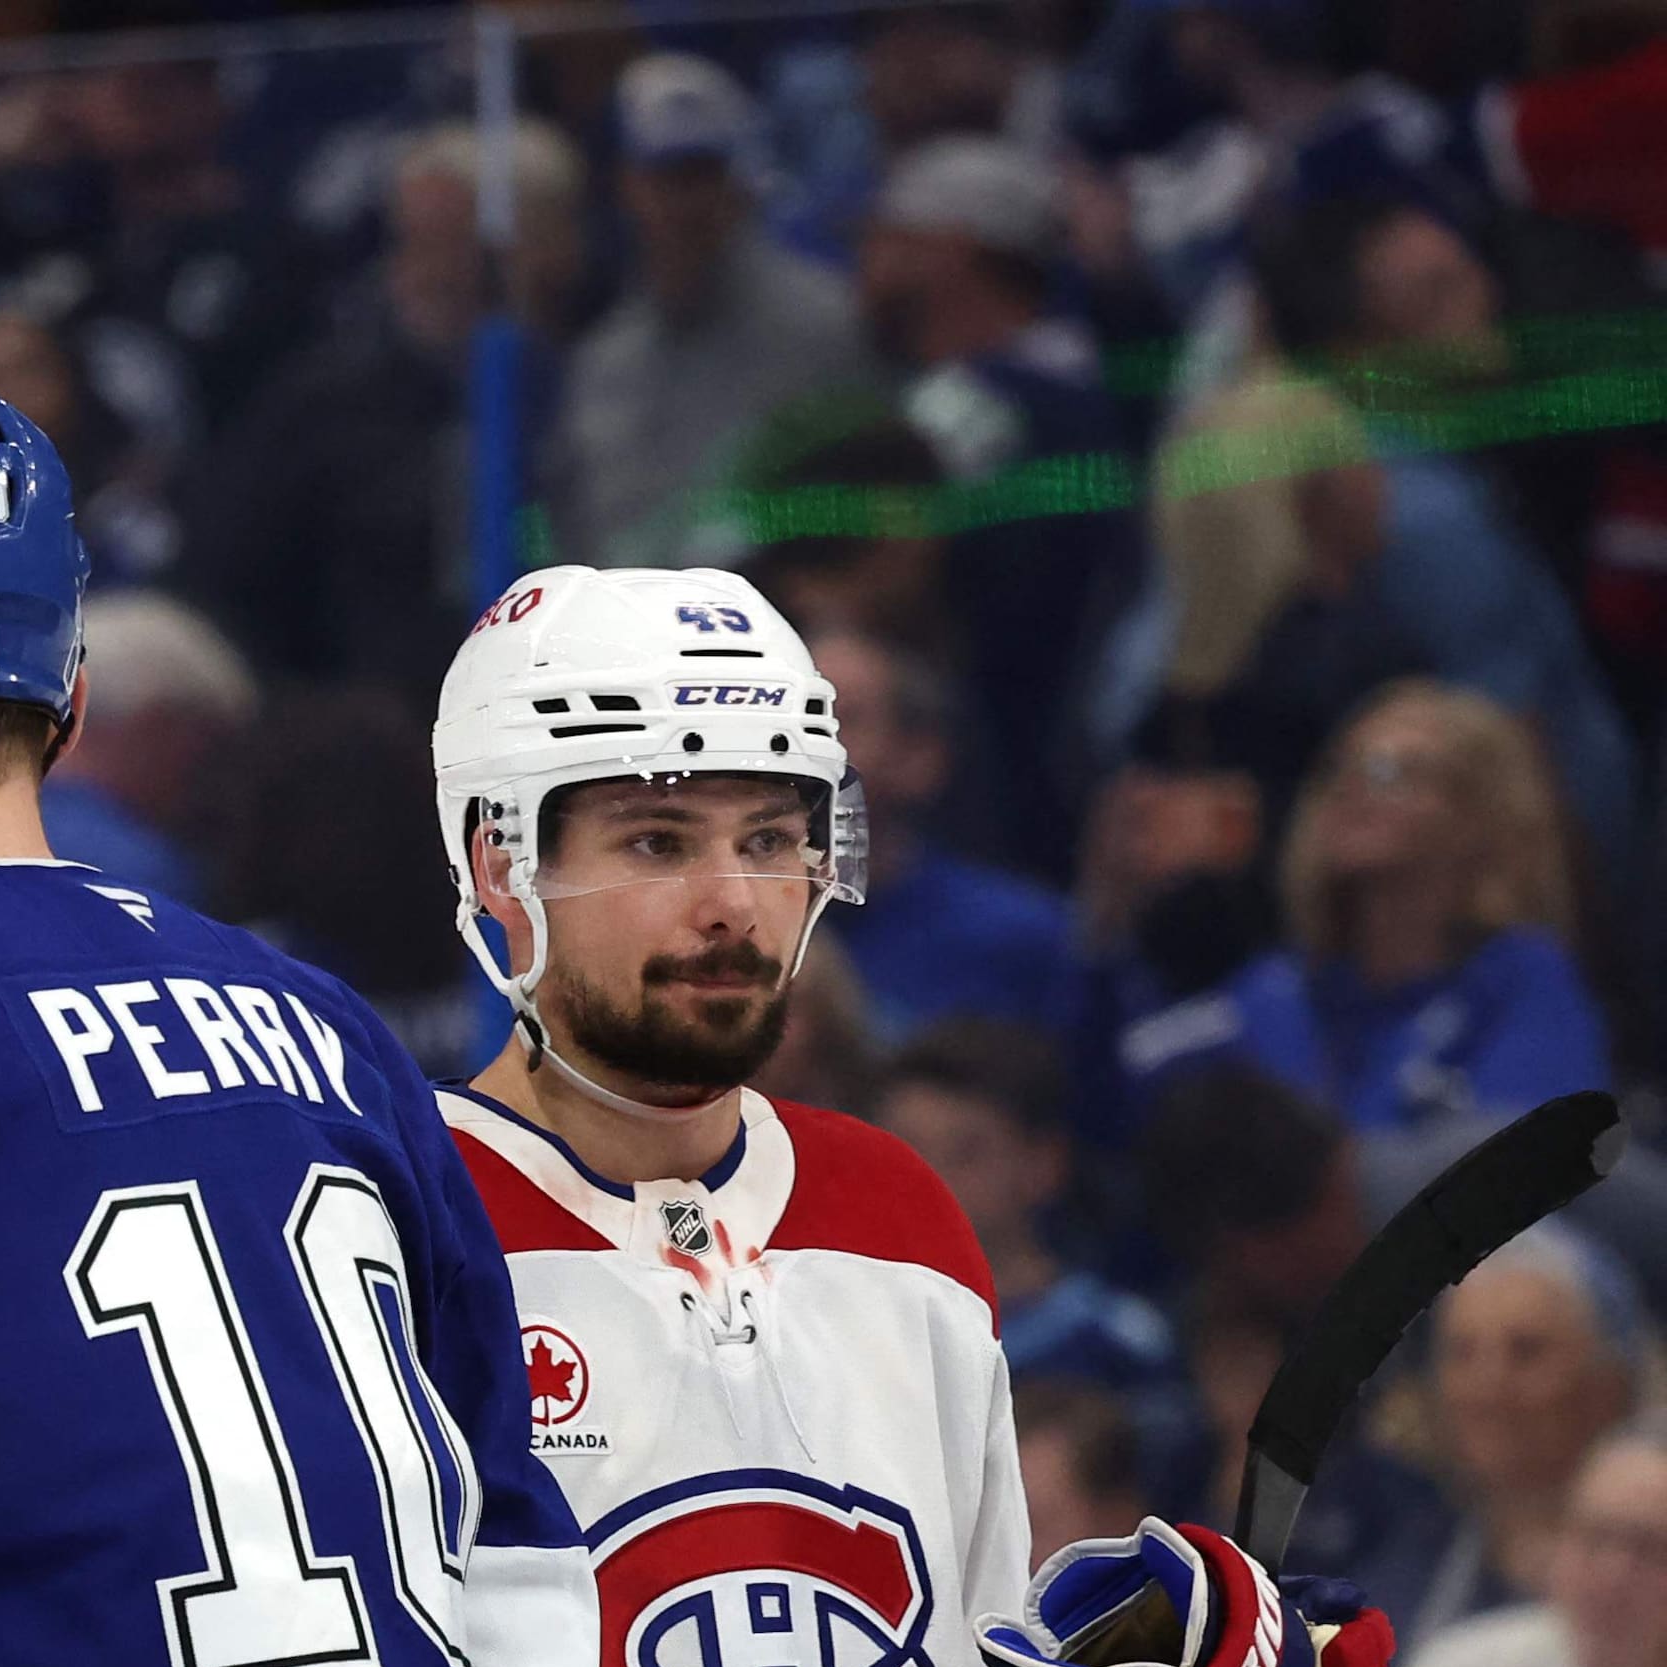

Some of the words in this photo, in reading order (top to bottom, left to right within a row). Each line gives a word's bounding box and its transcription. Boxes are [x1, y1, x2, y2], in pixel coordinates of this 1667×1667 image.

[674, 686, 787, 706] CCM
[27, 977, 364, 1118] PERRY
[530, 1434, 609, 1449] CANADA
